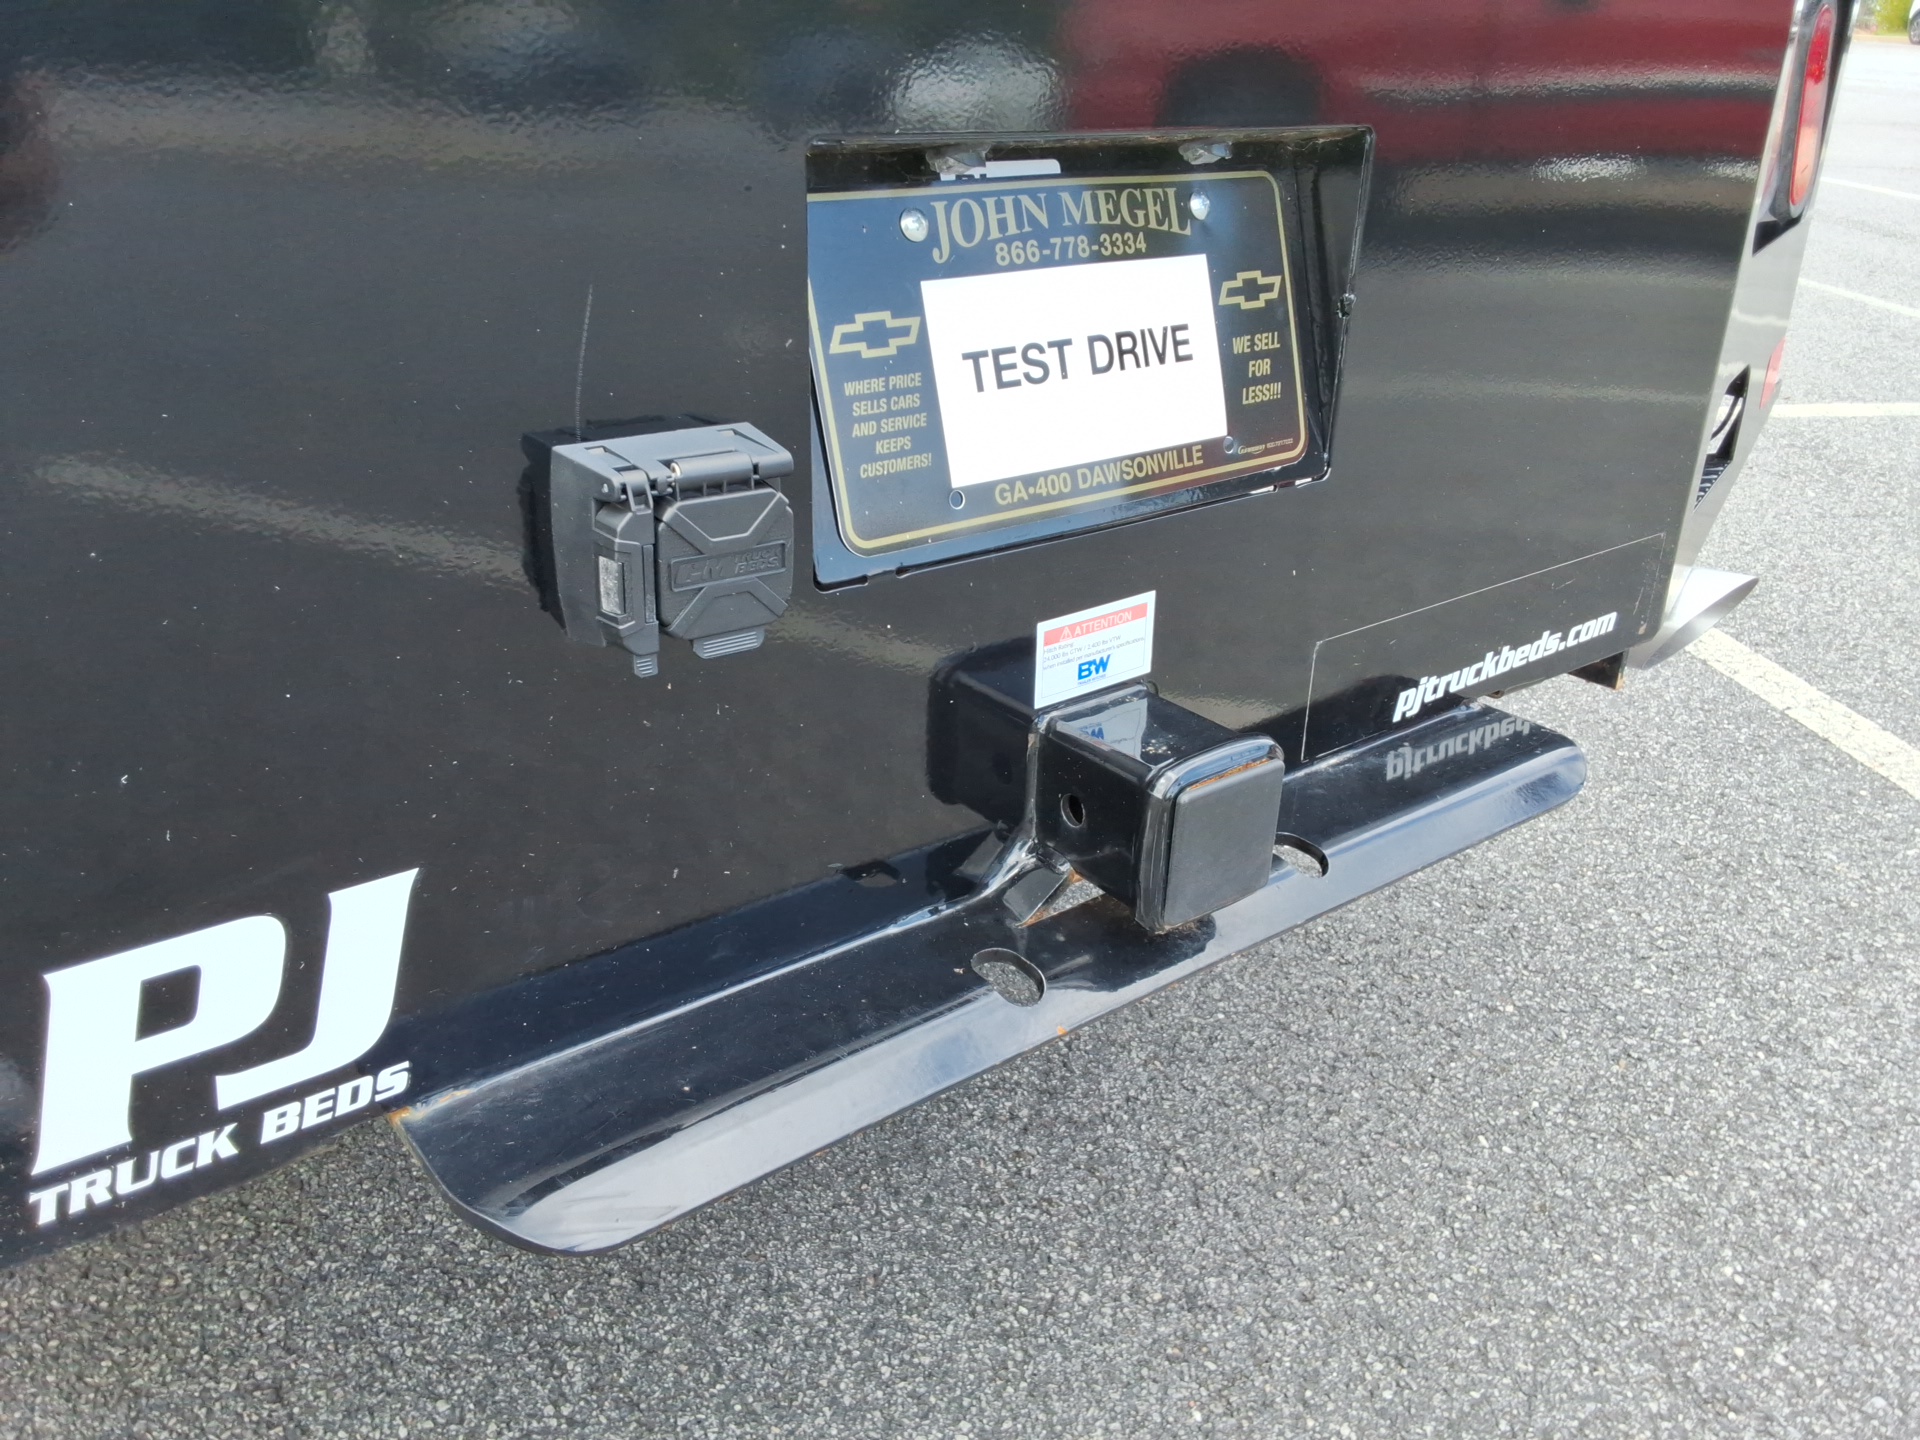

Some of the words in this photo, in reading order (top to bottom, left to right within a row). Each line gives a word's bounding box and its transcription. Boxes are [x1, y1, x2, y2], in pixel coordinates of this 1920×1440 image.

[930, 193, 1049, 264] JOHN
[1058, 187, 1191, 236] MEGEL
[995, 231, 1147, 266] 866-778-3334
[1232, 335, 1251, 355] WE
[1254, 331, 1280, 352] SELL
[961, 338, 1073, 393] TEST
[1087, 323, 1194, 375] DRIVE
[1248, 358, 1271, 378] FOR
[844, 377, 885, 396] WHERE
[889, 372, 922, 390] PRICE
[1242, 382, 1282, 405] LESS!!!
[852, 398, 887, 416] SELLS
[890, 393, 920, 411] CARS
[852, 421, 877, 438] AND
[880, 412, 927, 433] SERVICE
[876, 436, 911, 455] KEEPS
[860, 452, 932, 479] CUSTOMERS!
[1077, 445, 1204, 489] DAWSONVILLE
[1074, 611, 1132, 637] ATTENTION
[1392, 611, 1617, 723] pjtruckbeds.com
[31, 867, 420, 1176] PJ
[29, 1122, 239, 1226] TRUCK
[260, 1060, 412, 1145] BEDS
